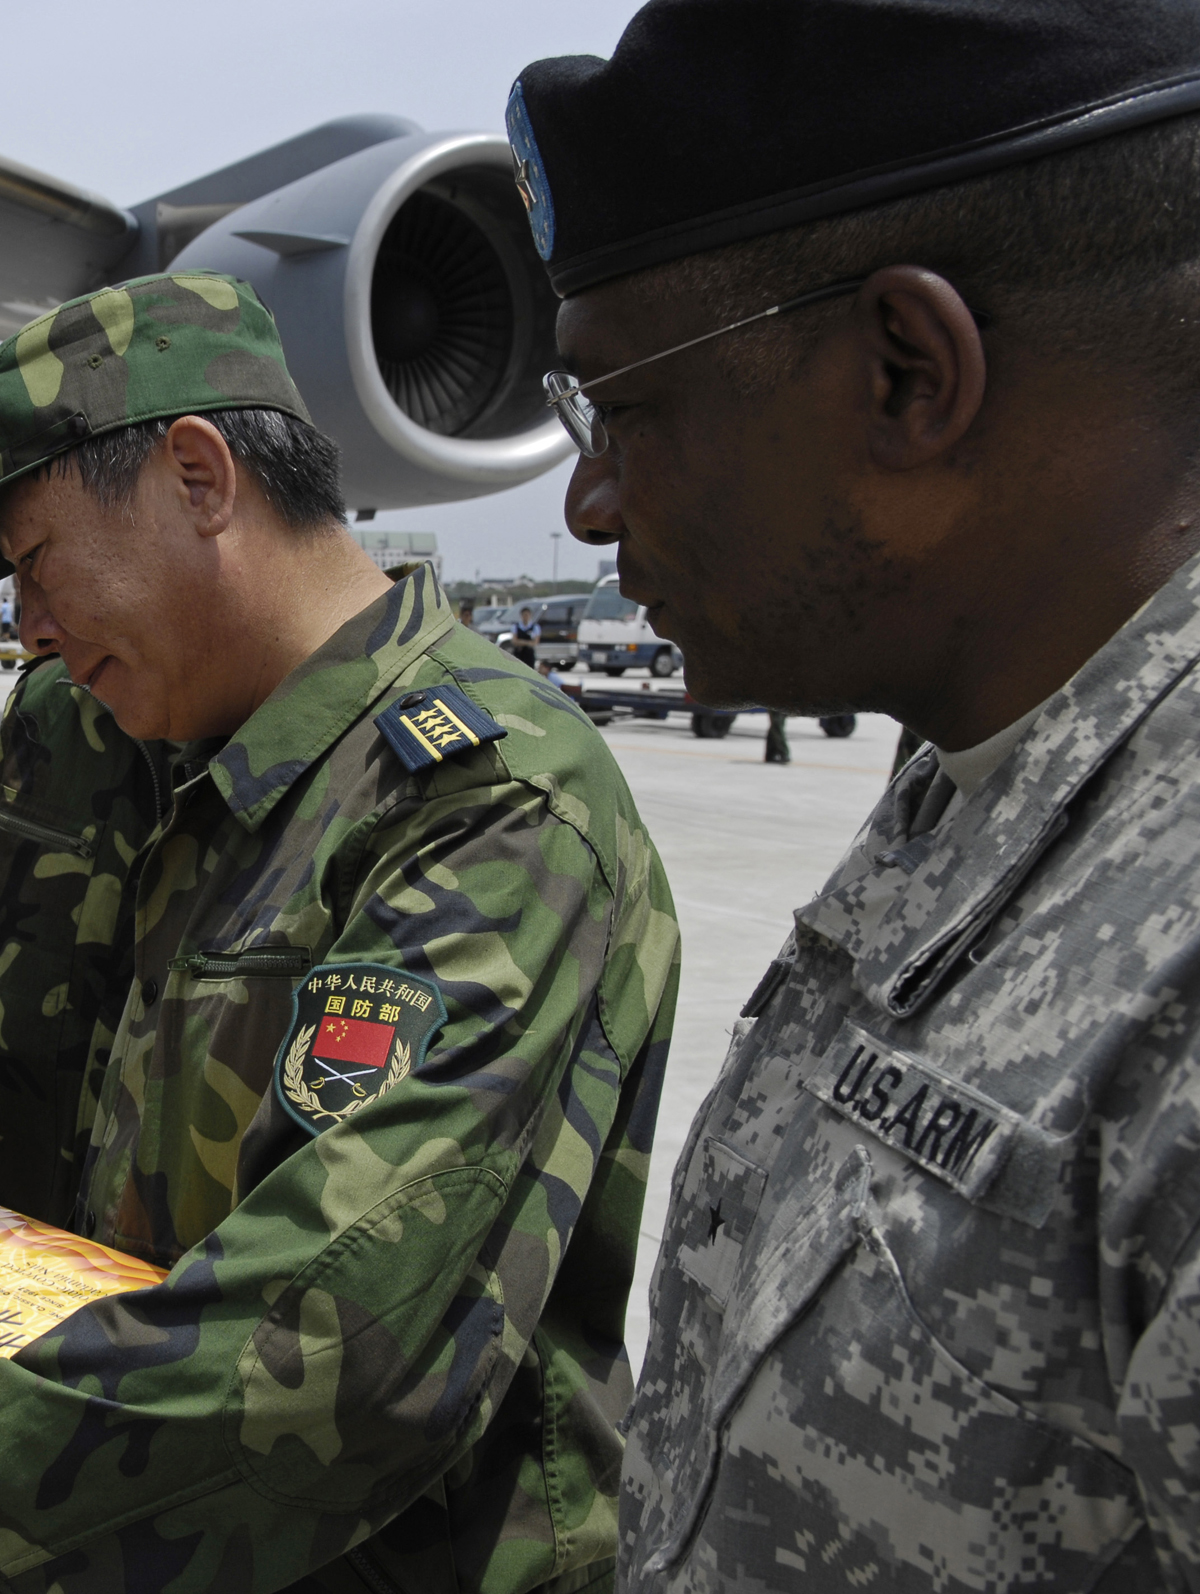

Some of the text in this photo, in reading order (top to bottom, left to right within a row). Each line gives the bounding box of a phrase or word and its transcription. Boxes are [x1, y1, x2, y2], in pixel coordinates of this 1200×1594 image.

[307, 973, 433, 1013] 中华人民共和国
[324, 995, 401, 1024] 国防部
[1, 1262, 55, 1287] Covered
